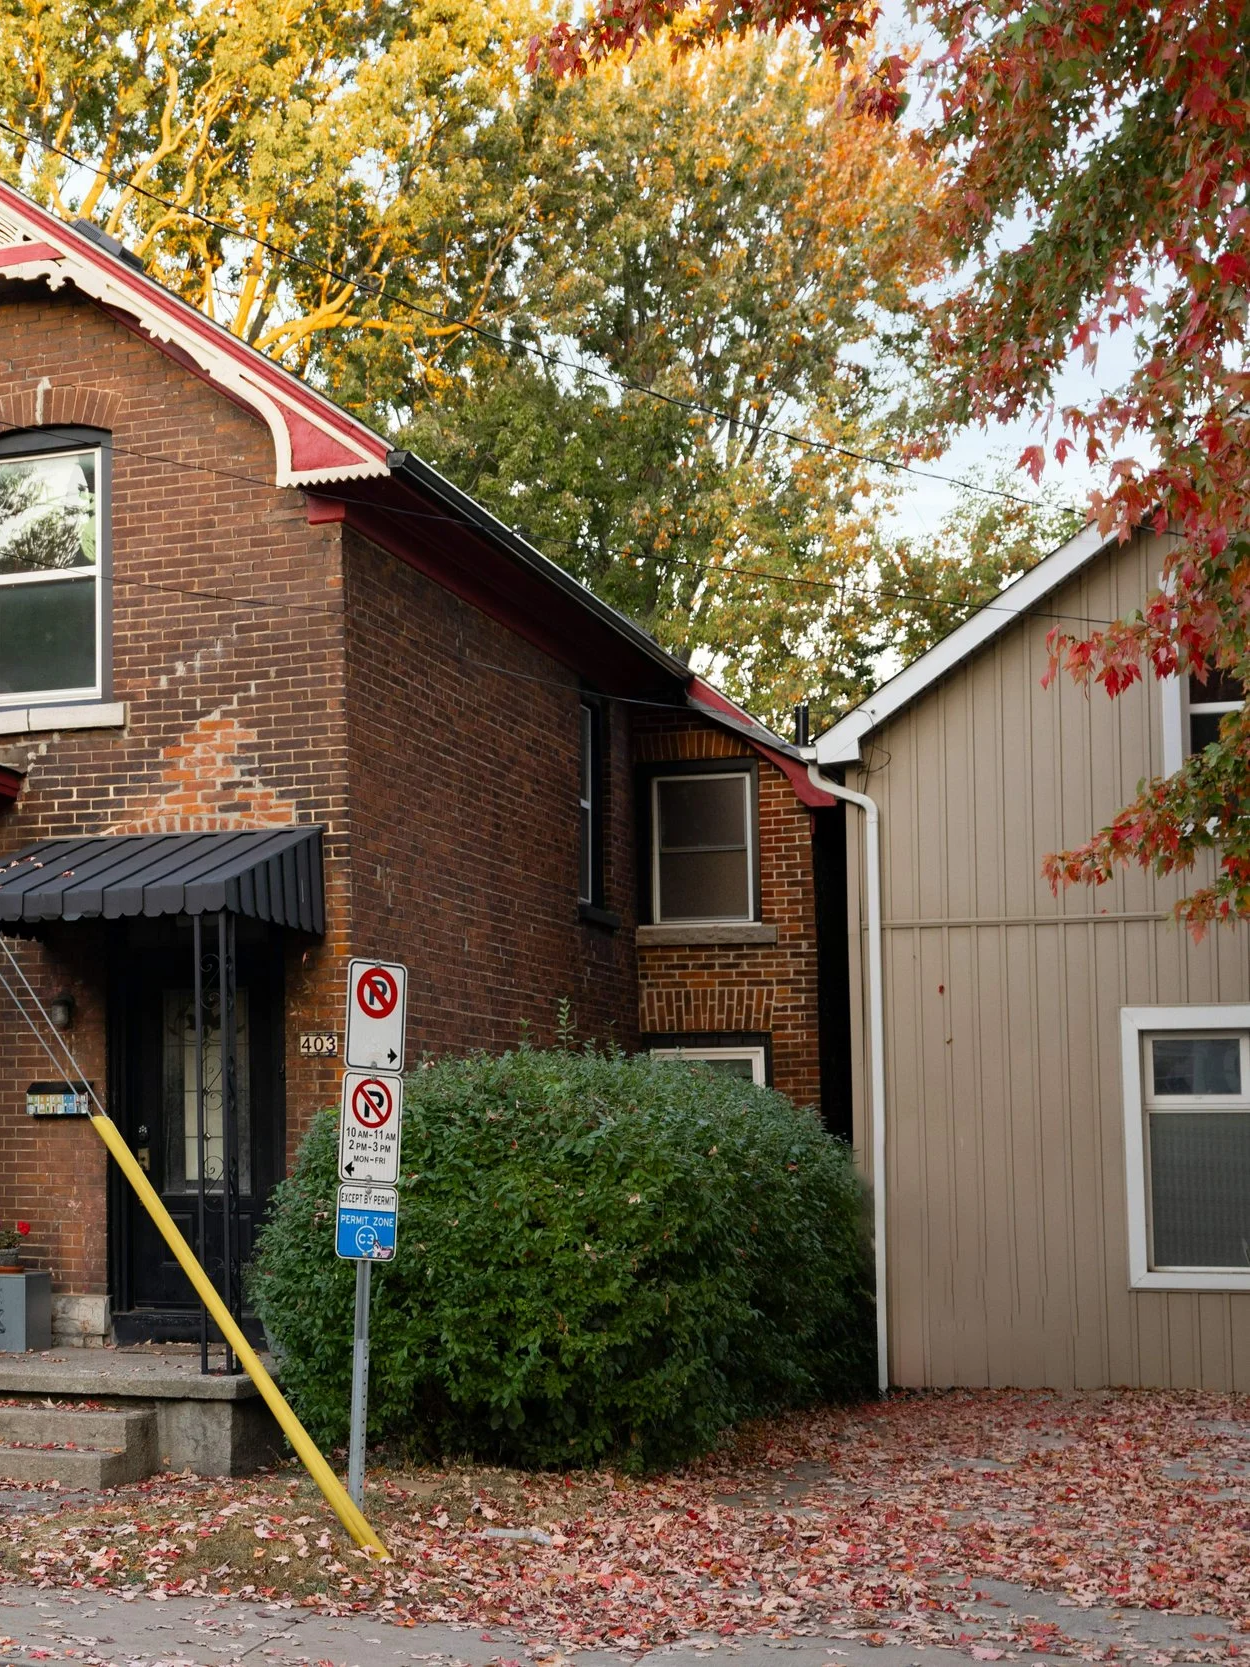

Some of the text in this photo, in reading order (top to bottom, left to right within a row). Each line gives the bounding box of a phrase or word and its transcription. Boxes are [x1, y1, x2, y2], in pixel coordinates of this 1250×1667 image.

[301, 1036, 336, 1052] 403
[346, 1126, 357, 1138] 10
[385, 1132, 396, 1141] AM
[348, 1139, 355, 1150] 2
[380, 1144, 391, 1153] PM
[341, 1192, 395, 1206] EXCEPT BY PERMIT
[340, 1214, 394, 1227] PERMIT ZONE
[358, 1233, 375, 1245] C3
